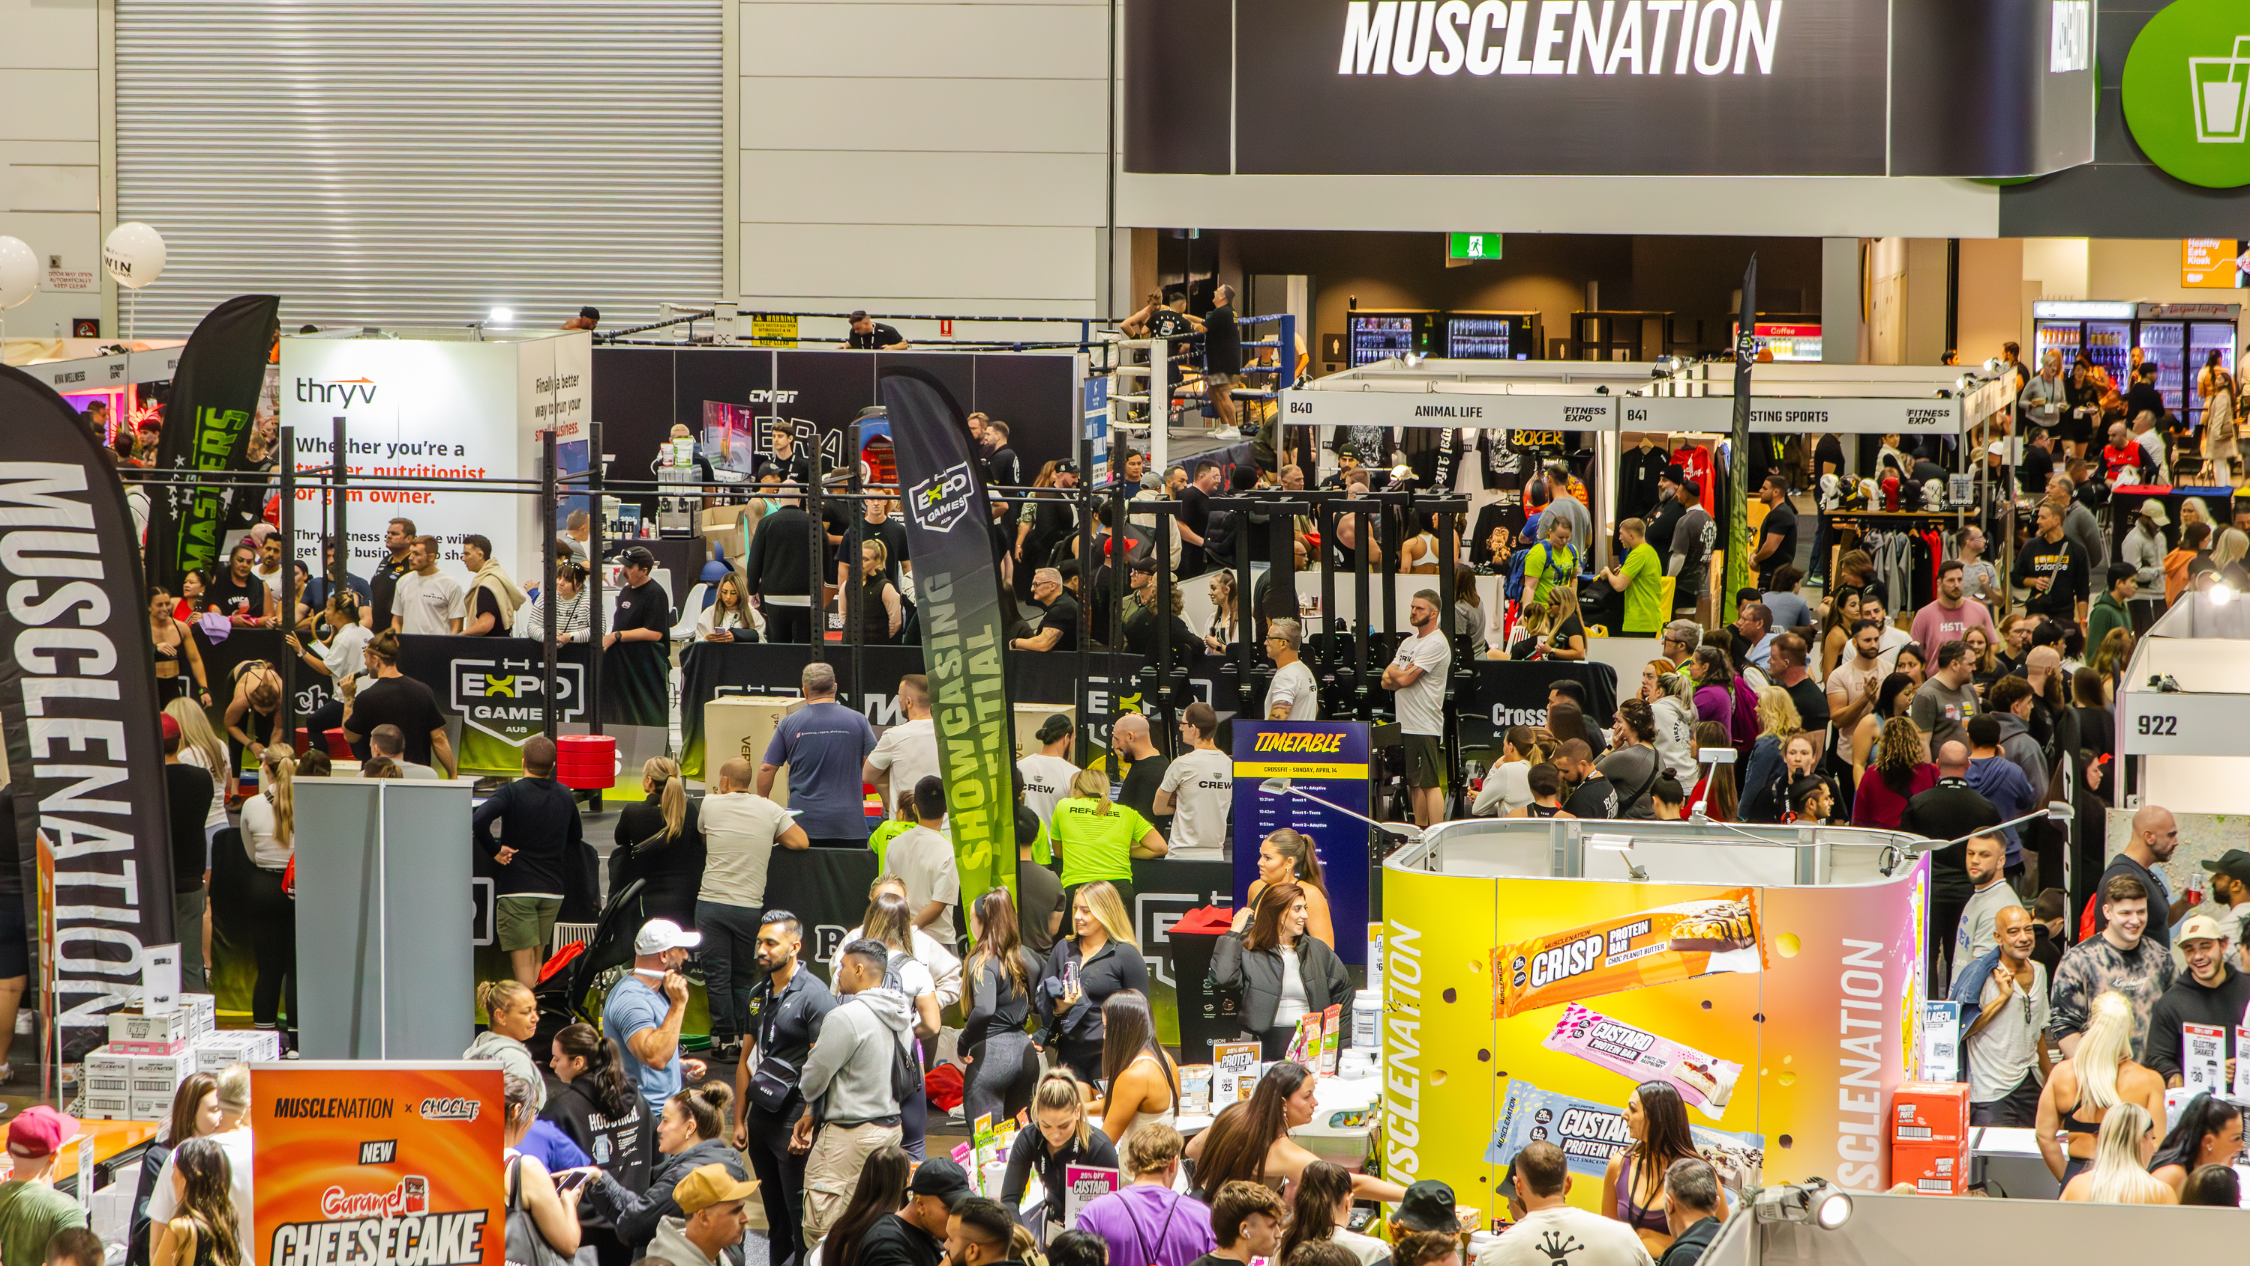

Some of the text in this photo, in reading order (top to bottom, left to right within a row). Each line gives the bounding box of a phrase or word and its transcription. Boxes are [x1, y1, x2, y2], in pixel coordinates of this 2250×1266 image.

[1338, 0, 1782, 75] MUSCLENATION
[2188, 239, 2220, 249] Healthy
[2188, 248, 2207, 256] Eats
[103, 255, 132, 273] WIN
[2187, 257, 2210, 265] Kiosk
[1771, 327, 1795, 335] Coffee
[561, 374, 579, 389] better
[296, 377, 377, 409] thryv
[535, 404, 547, 421] way
[556, 401, 566, 414] run
[568, 398, 581, 416] your
[1290, 402, 1483, 418] 840 ANIMAL LIFE
[1564, 407, 1606, 415] FITNESS
[1627, 410, 1647, 421] 841
[1785, 411, 1828, 422] SPORTS
[1908, 409, 1949, 418] FITNESS
[1908, 417, 1935, 425] EXPO
[1511, 429, 1565, 446] BOXER
[296, 437, 381, 454] Wheher
[454, 444, 465, 456] a
[374, 463, 486, 479] nutritionist
[182, 407, 249, 572] MASTERS
[296, 488, 435, 505] or gm owner.
[918, 474, 966, 510] EXPO
[927, 497, 965, 522] GAMES
[941, 516, 952, 525] AUS
[346, 531, 380, 542] tness
[296, 547, 317, 558] get
[1940, 622, 1967, 631] HSTL
[462, 673, 572, 699] EXPO
[474, 705, 559, 721] GAME
[924, 572, 992, 870] SHOWCASING
[2138, 715, 2177, 736] 922
[1255, 732, 1347, 753] TIMETABLE
[1024, 784, 1055, 794] CREW
[1199, 781, 1233, 790] CREW
[1069, 807, 1121, 818] REFEEE
[1544, 930, 1591, 949] MUSCLENATION
[1609, 920, 1649, 944] PROTEIN
[1608, 943, 1665, 965] CHOC PEANUT BUTTER
[1609, 940, 1628, 956] BAR
[1531, 934, 1603, 988] CRISP
[1927, 1011, 1951, 1022] LAGEN
[1592, 1022, 1655, 1051] CUSTARD
[2193, 1040, 2217, 1050] ELECTRIC
[1590, 1039, 1638, 1060] PROTEIN BAR
[2194, 1048, 2214, 1057] SHAKER
[1220, 1051, 1254, 1068] PROTEIN
[1387, 918, 1421, 1218] USCLENATION
[1837, 938, 1884, 1193] SCLENATION
[274, 1098, 394, 1119] MUSCLENATION
[1496, 1097, 1516, 1150] MUSCLENATION
[1558, 1108, 1637, 1144] CUSTAR
[361, 1142, 395, 1163] NEW
[1563, 1138, 1608, 1158] PROTEIN
[1073, 1180, 1110, 1195] CUSTARD
[321, 1183, 405, 1219] Caramel
[272, 1210, 487, 1266] CHEESECAKE
